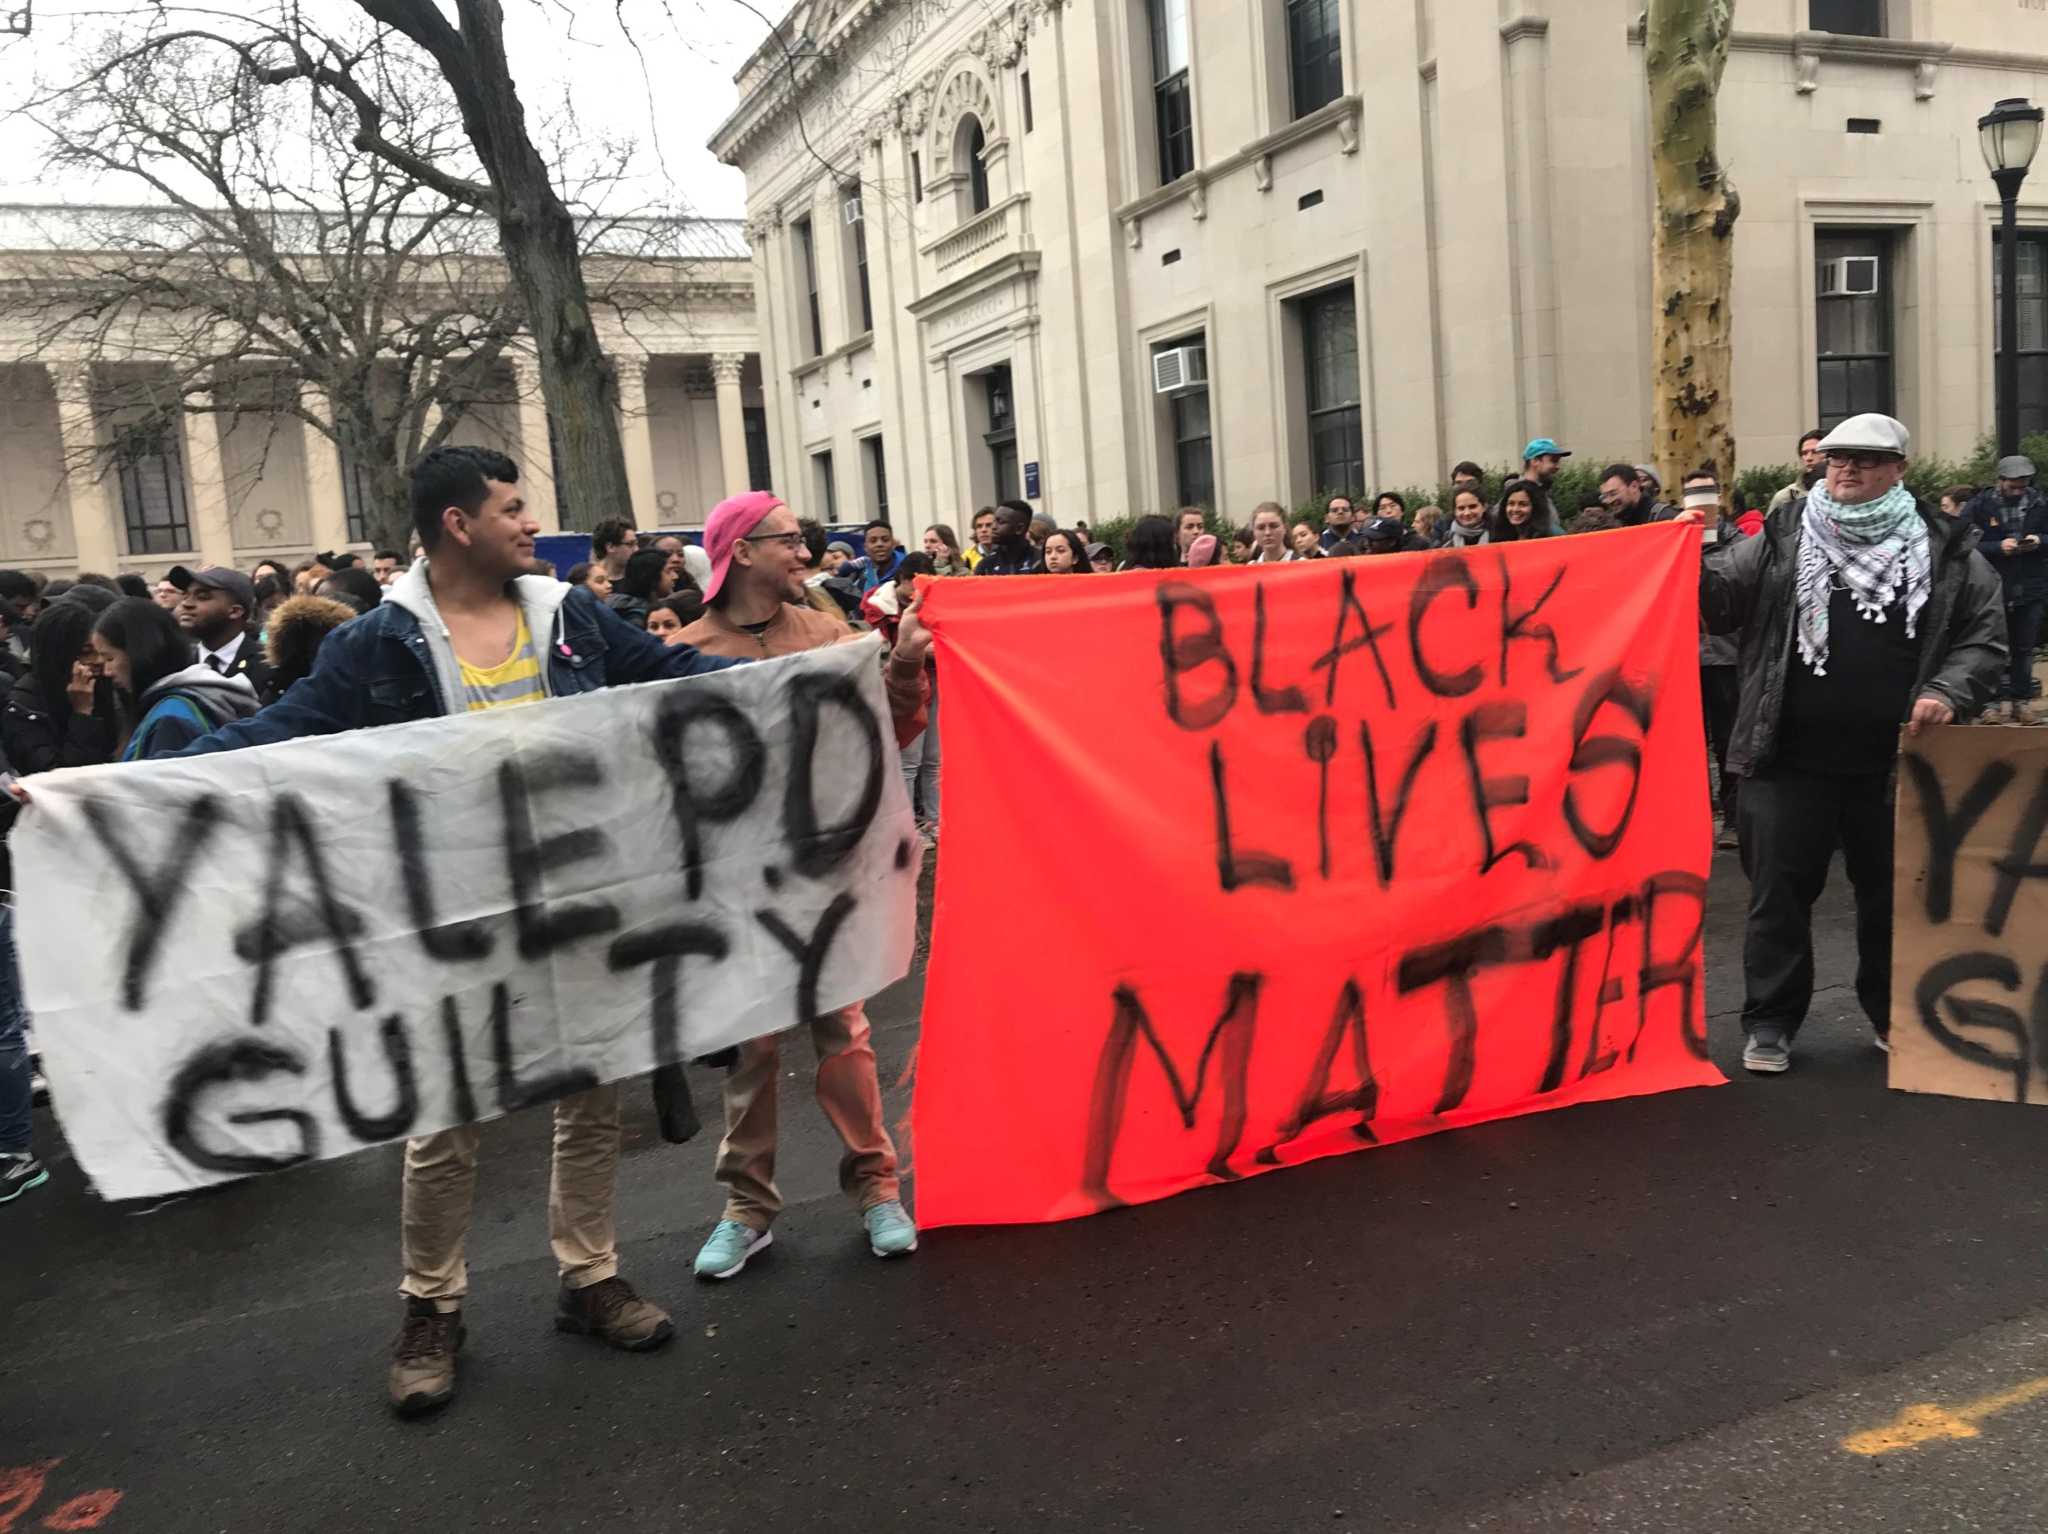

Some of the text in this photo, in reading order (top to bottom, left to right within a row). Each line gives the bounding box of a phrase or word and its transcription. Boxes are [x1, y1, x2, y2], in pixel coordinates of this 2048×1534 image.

[1156, 552, 1583, 731] BLACK
[78, 745, 621, 1027] YALE
[1914, 952, 2048, 1102] G
[162, 890, 858, 1174] GUILTY
[1079, 869, 1709, 1202] MATTER
